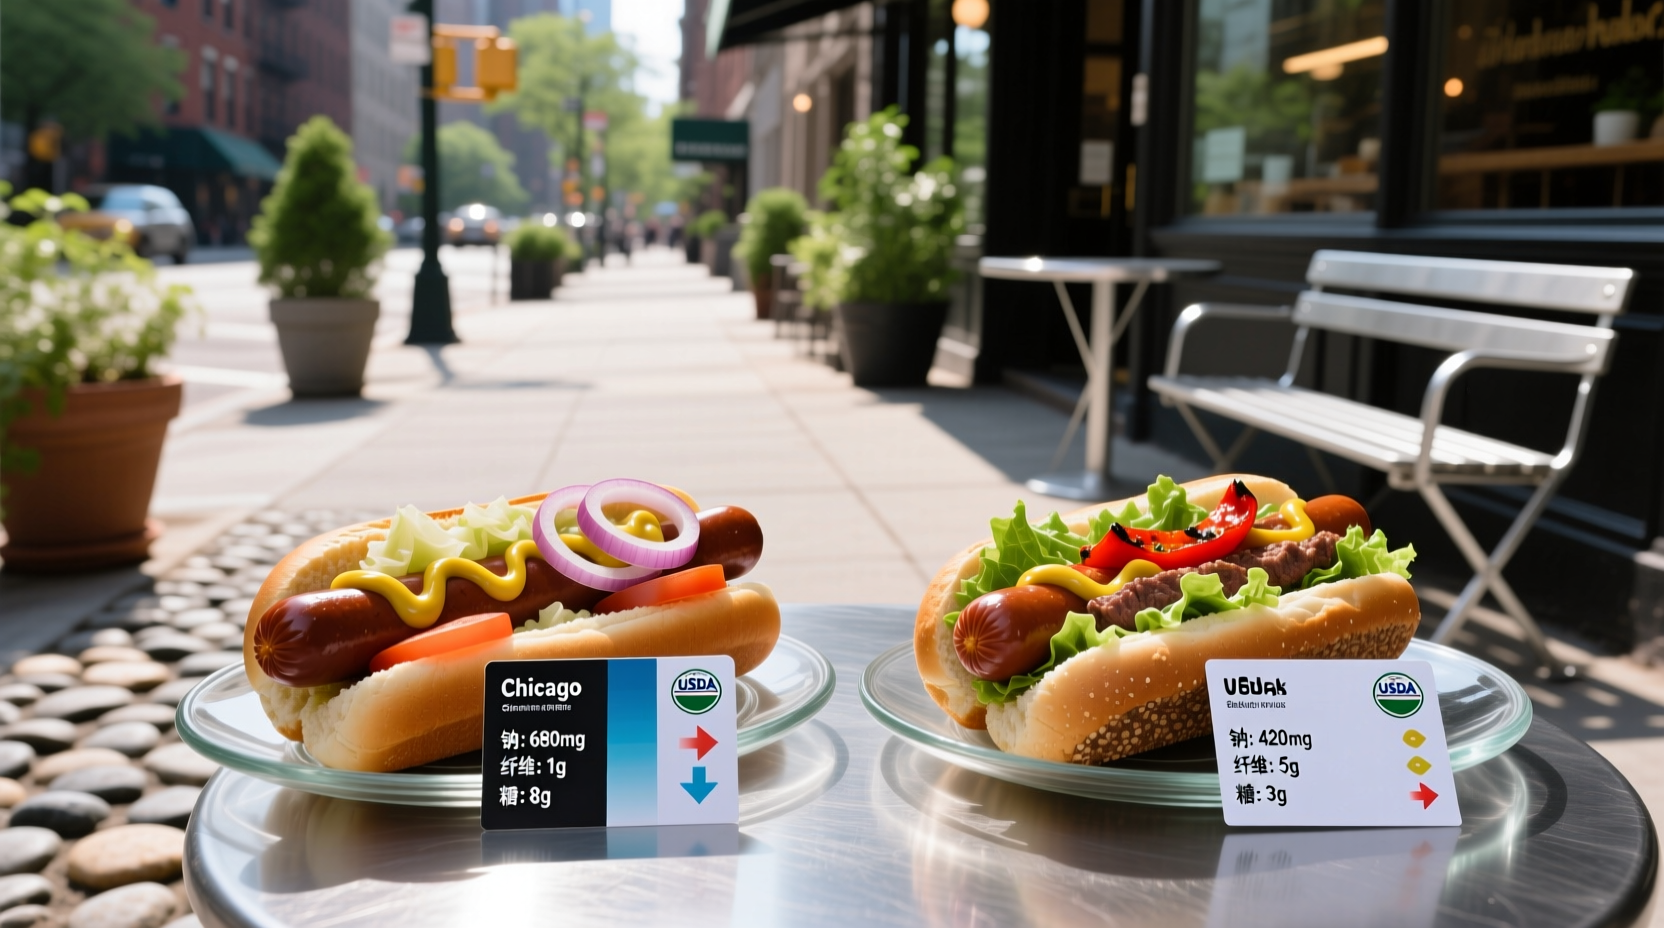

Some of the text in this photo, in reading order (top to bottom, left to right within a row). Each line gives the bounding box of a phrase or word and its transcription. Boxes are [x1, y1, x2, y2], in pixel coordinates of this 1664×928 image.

[501, 677, 582, 702] Chicago
[678, 677, 718, 692] USDA
[1378, 681, 1417, 694] USDA
[529, 730, 586, 751] 680mg
[1258, 729, 1312, 751] 420mg
[546, 757, 567, 779] 1g
[1278, 756, 1300, 778] 5g
[529, 786, 551, 809] 8g
[1265, 785, 1288, 807] 3g
